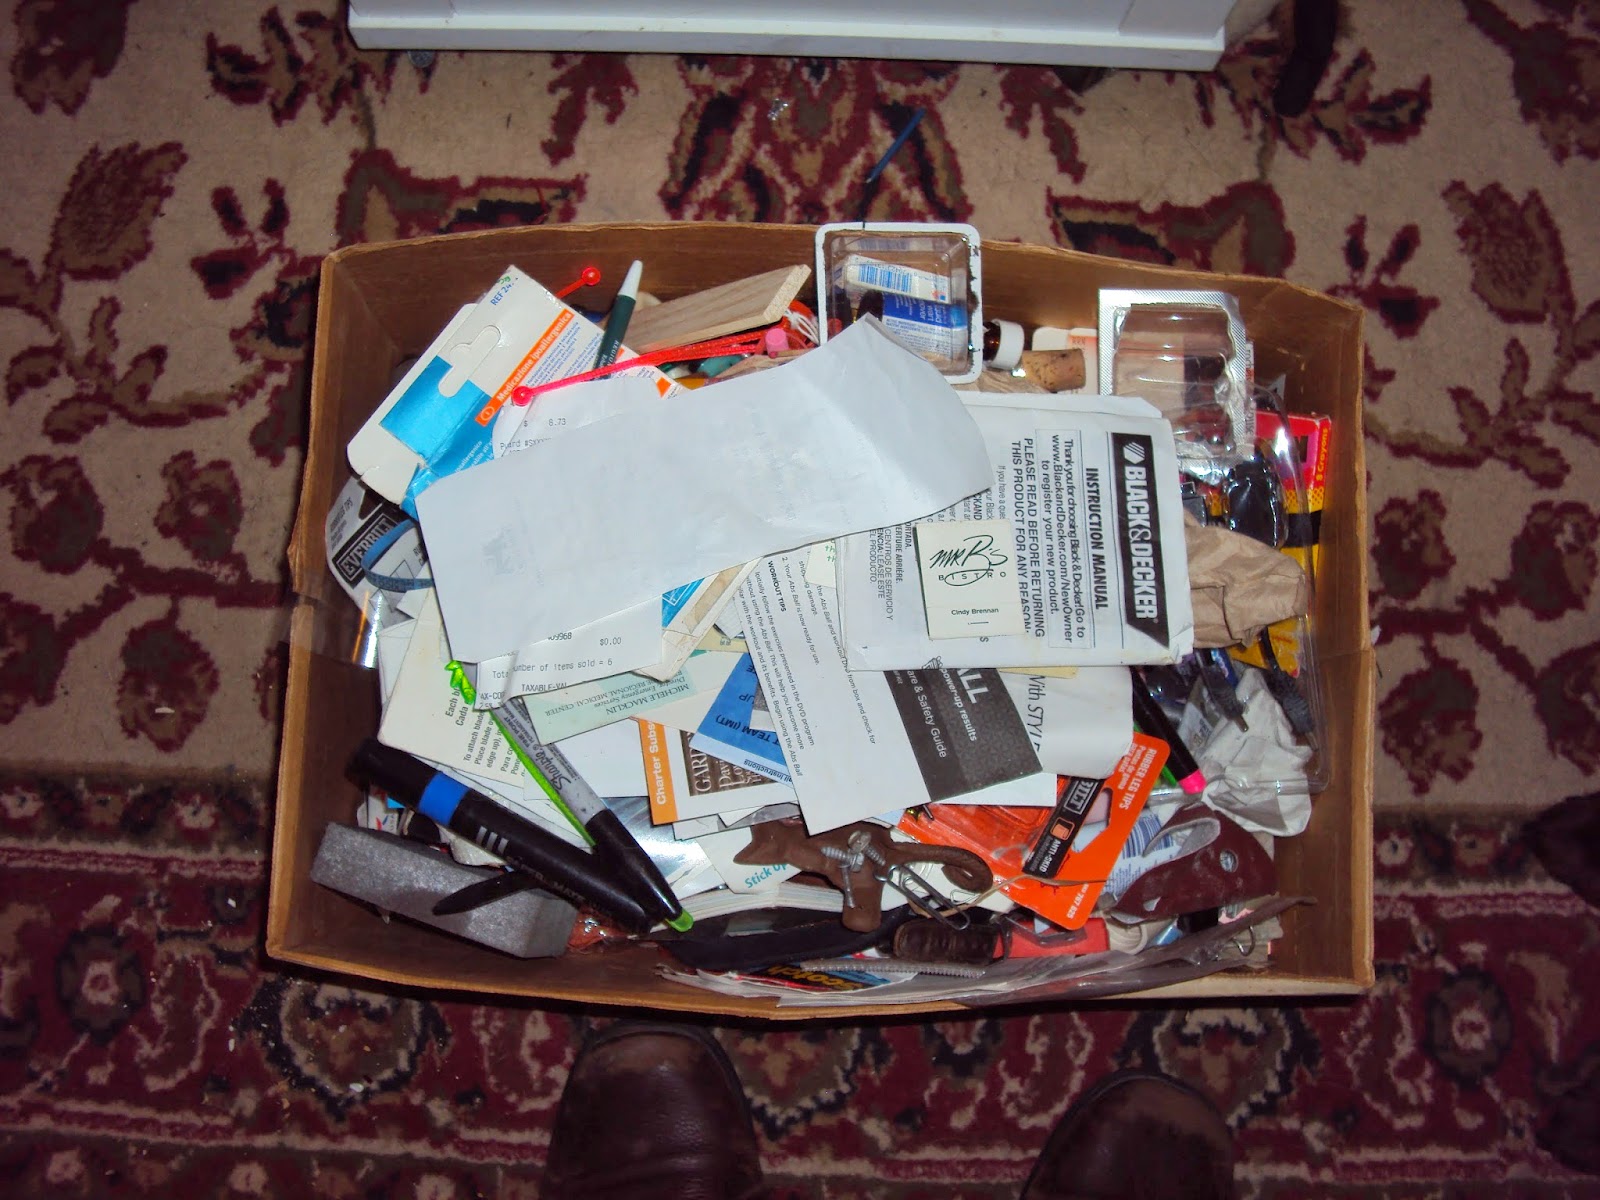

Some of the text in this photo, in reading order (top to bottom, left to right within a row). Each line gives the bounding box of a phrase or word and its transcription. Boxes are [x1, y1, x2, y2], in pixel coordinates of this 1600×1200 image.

[490, 291, 504, 305] REF
[496, 357, 534, 402] Medicazione
[548, 417, 566, 426] 8.73
[1317, 427, 1328, 472] Crayons
[997, 470, 1006, 481] you
[998, 483, 1007, 498] have
[985, 502, 995, 520] Black
[1010, 441, 1027, 577] THIS PRODUCT FOR ANY
[1066, 497, 1079, 537] choosing
[1021, 437, 1045, 637] PLEASE READ BEFORE RETURNING
[1039, 459, 1060, 614] to register your new product.
[1050, 434, 1073, 642] www.BlackandDecker.com/NewOwner
[1085, 467, 1108, 609] INSTRUCTION MANUAL
[1123, 464, 1157, 619] BLACK&DECKER
[868, 539, 876, 583] PRODUCTO.
[1069, 538, 1081, 563] Black
[782, 563, 792, 579] Your
[884, 567, 891, 577] DE
[938, 571, 1006, 581] BISTRO
[765, 559, 787, 612] WORKOUT TIPS
[787, 579, 797, 593] Abs
[1071, 572, 1084, 608] Decker!
[760, 594, 772, 614] follow
[791, 593, 801, 607] Ball
[805, 589, 819, 616] damage.
[766, 614, 776, 625] the
[797, 612, 808, 626] now
[1073, 608, 1085, 623] Go
[598, 636, 621, 646] $0.00
[769, 625, 785, 653] exercises
[802, 626, 814, 644] ready
[1075, 626, 1086, 638] to
[807, 643, 817, 653] for
[811, 653, 821, 665] use.
[539, 663, 548, 671] of
[553, 661, 574, 671] items
[577, 659, 595, 668] sold
[750, 598, 805, 750] using the Abs Ball. This will help you become more
[778, 652, 795, 684] presented
[815, 584, 877, 745] the Abs Ball and workout from box and check for
[574, 691, 607, 707] MEDICAL
[593, 684, 655, 709] Emergency Services
[604, 683, 689, 714] MICHELE MACKLIN
[608, 680, 645, 696] REGIONAL
[740, 599, 803, 777] with the workout and its benefits. Begin using the Abs Ball
[791, 690, 801, 702] the
[913, 684, 923, 693] &
[444, 697, 458, 717] Each
[455, 705, 468, 726] Cada
[544, 702, 574, 716] CENTER
[795, 702, 807, 718] DVD
[916, 693, 936, 726] Safety
[463, 710, 485, 761] To attach blade
[503, 715, 520, 734] POINT
[714, 713, 771, 741] TEAM (IMT)
[800, 717, 815, 746] program
[959, 708, 977, 741] results
[474, 725, 492, 765] Place blade
[485, 736, 501, 768] edge up),
[517, 733, 530, 748] FINE
[929, 726, 948, 758] Guide
[500, 755, 511, 772] Para
[532, 747, 570, 789] Sharpie
[646, 722, 665, 804] Charter Subs
[742, 759, 783, 780] Instructions
[1118, 746, 1157, 811] RUBBER LEG TIPS
[1038, 838, 1061, 872] ANTI-SKID
[744, 866, 772, 888] Stick
